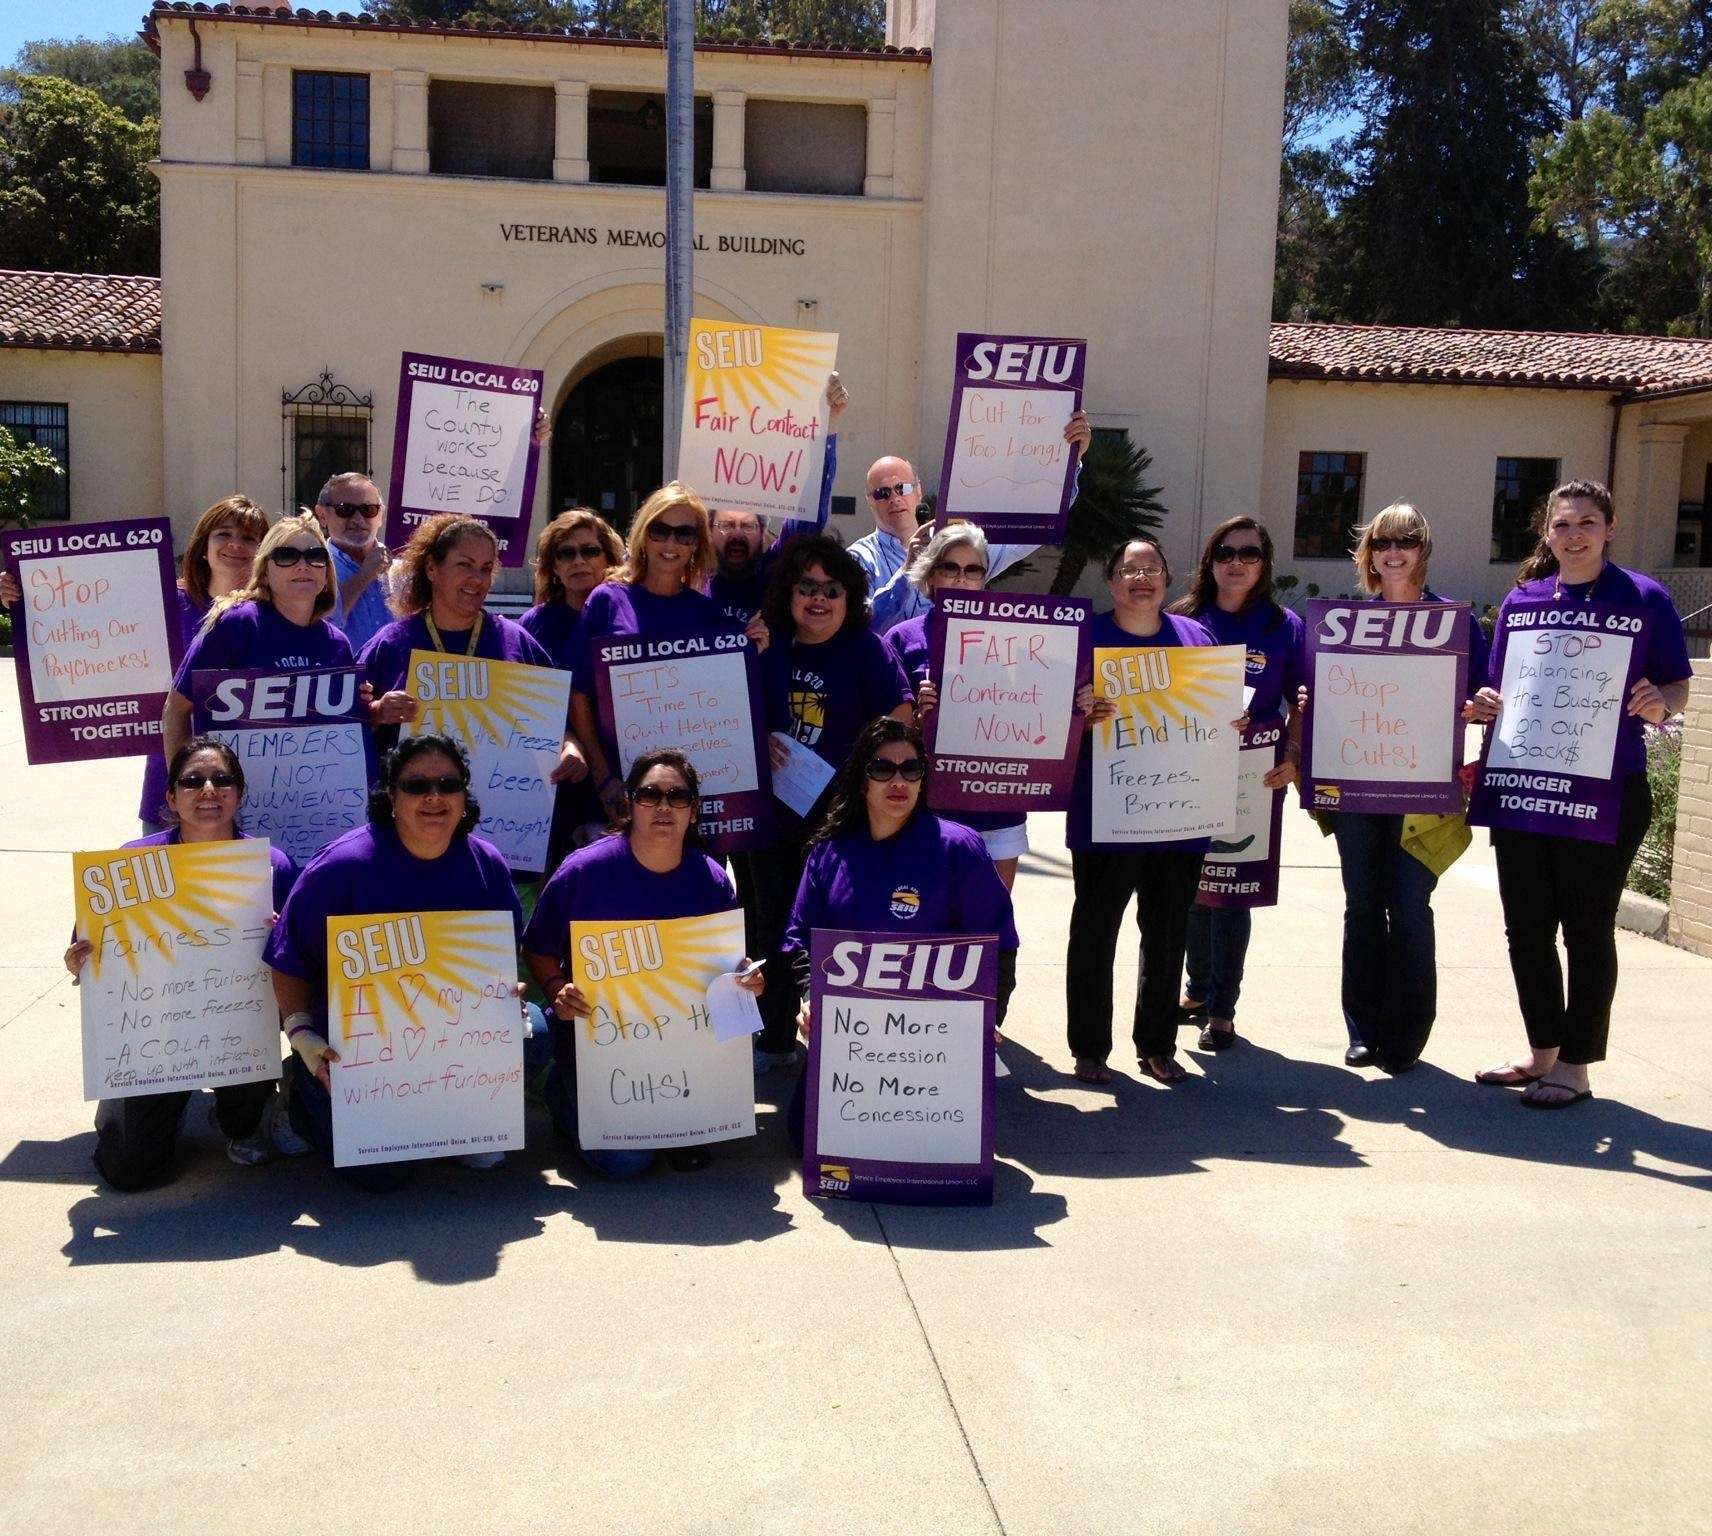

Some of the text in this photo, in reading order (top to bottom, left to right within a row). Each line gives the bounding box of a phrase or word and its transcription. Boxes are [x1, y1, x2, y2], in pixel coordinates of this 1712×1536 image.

[500, 224, 805, 255] VETERANS MEMOL BUILDING
[696, 329, 763, 370] SEIU
[968, 342, 1077, 383] SEIU
[408, 362, 539, 392] SEIU LOCAL 620
[454, 390, 490, 413] The
[970, 393, 1049, 425] Cut for
[425, 410, 502, 447] County
[695, 397, 819, 441] Fair Contract
[965, 434, 997, 458] Too
[422, 456, 501, 482] because
[715, 447, 802, 493] NOW!
[428, 482, 461, 501] WE
[11, 529, 163, 556] SEIU LOCAL 620
[31, 566, 110, 613] Stop
[943, 599, 1085, 622] SEIU LOCAL 620
[1506, 610, 1643, 633] SEIU LOCAL 620
[32, 618, 101, 649] Cutting
[1320, 608, 1457, 648] SEIU
[601, 634, 748, 662] SEIU LOCAL 620
[960, 630, 1049, 669] FAIR
[1533, 633, 1601, 657] STOP
[416, 661, 489, 701] SEIU
[804, 672, 824, 689] 620
[1100, 649, 1171, 700] SEIU
[1328, 664, 1399, 708] Stop
[1519, 659, 1612, 687] balancing
[211, 673, 356, 721] SEIU
[636, 690, 719, 715] Time To
[950, 674, 1043, 706] Contract
[1512, 686, 1619, 718] the Budget
[39, 700, 140, 722] STRONGER
[1351, 710, 1408, 736] the
[975, 713, 1046, 745] NOW!
[1115, 715, 1219, 750] End the
[1252, 729, 1280, 745] 620
[1516, 718, 1593, 737] on our
[218, 729, 361, 758] MEMBERS
[1340, 738, 1417, 769] Cuts!
[272, 763, 340, 788] NOT
[488, 762, 544, 792] been
[935, 759, 1029, 776] STRONGER
[960, 780, 1052, 795] TOGETHER
[1484, 773, 1572, 794] STRONGER
[245, 787, 364, 809] NUMENTS
[1314, 796, 1339, 805] SEIU
[1500, 795, 1598, 820] TOGETHER
[241, 811, 356, 831] ERVICES
[698, 818, 754, 835] ETHER
[281, 830, 323, 844] NOT
[82, 849, 176, 915] SEIU
[1199, 880, 1260, 894] GETHER
[99, 920, 231, 963] Fairness
[336, 914, 427, 980] SEIU
[578, 922, 664, 982] SEIU
[826, 941, 983, 991] SEIU
[162, 975, 197, 995] more
[161, 1008, 196, 1023] more
[438, 987, 462, 1025] my
[590, 1003, 712, 1046] Stop th
[834, 1007, 949, 1036] No More
[221, 1030, 242, 1047] to
[459, 1030, 512, 1048] more
[848, 1042, 947, 1064] Recession
[344, 1073, 437, 1105] without
[610, 1068, 690, 1105] Cuts!
[832, 1072, 940, 1097] No More
[840, 1100, 965, 1122] Concessions
[819, 1180, 850, 1191] SEIU
